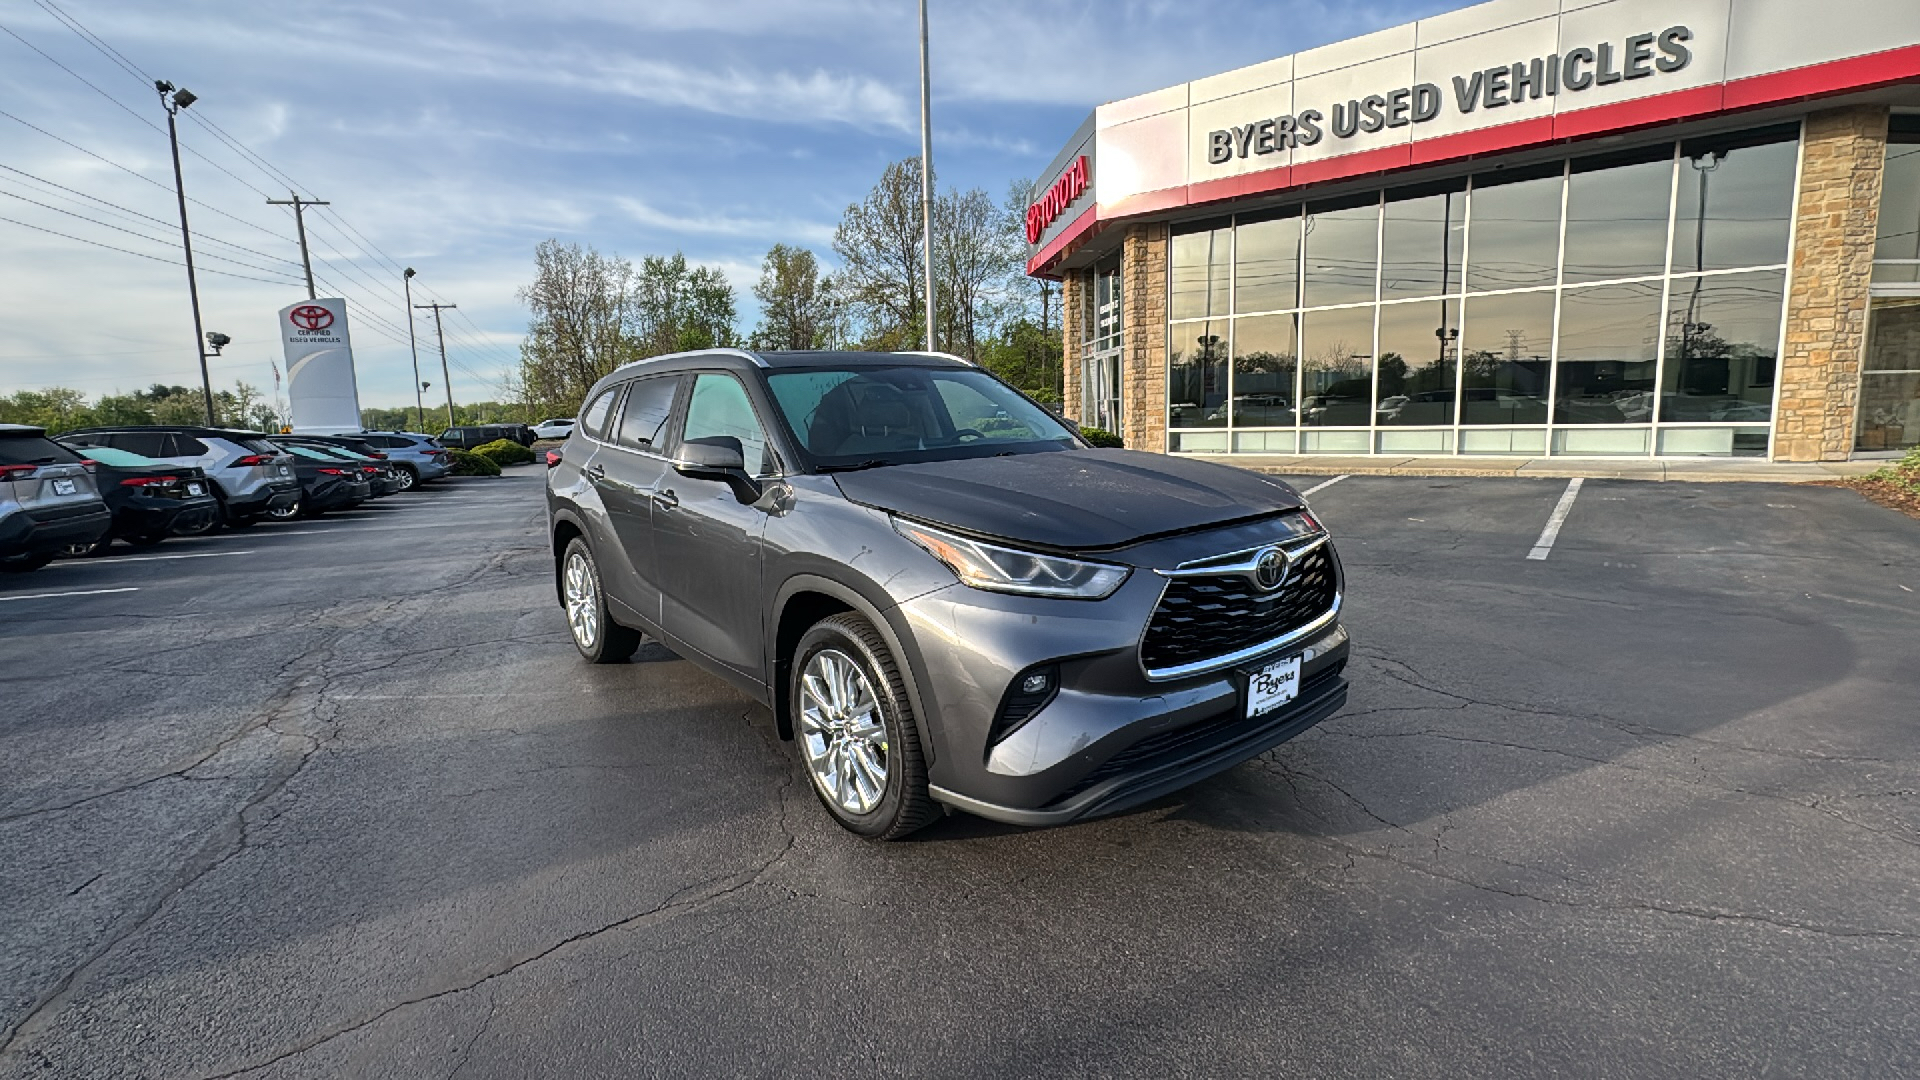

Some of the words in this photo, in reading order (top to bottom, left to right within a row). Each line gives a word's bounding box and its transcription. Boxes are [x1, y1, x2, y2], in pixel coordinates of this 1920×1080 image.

[1208, 109, 1323, 164] BYERS
[1332, 83, 1441, 138] USED
[1452, 25, 1692, 113] VEHICLES
[1040, 155, 1088, 229] TOYOTA
[1252, 671, 1294, 695] Byers
